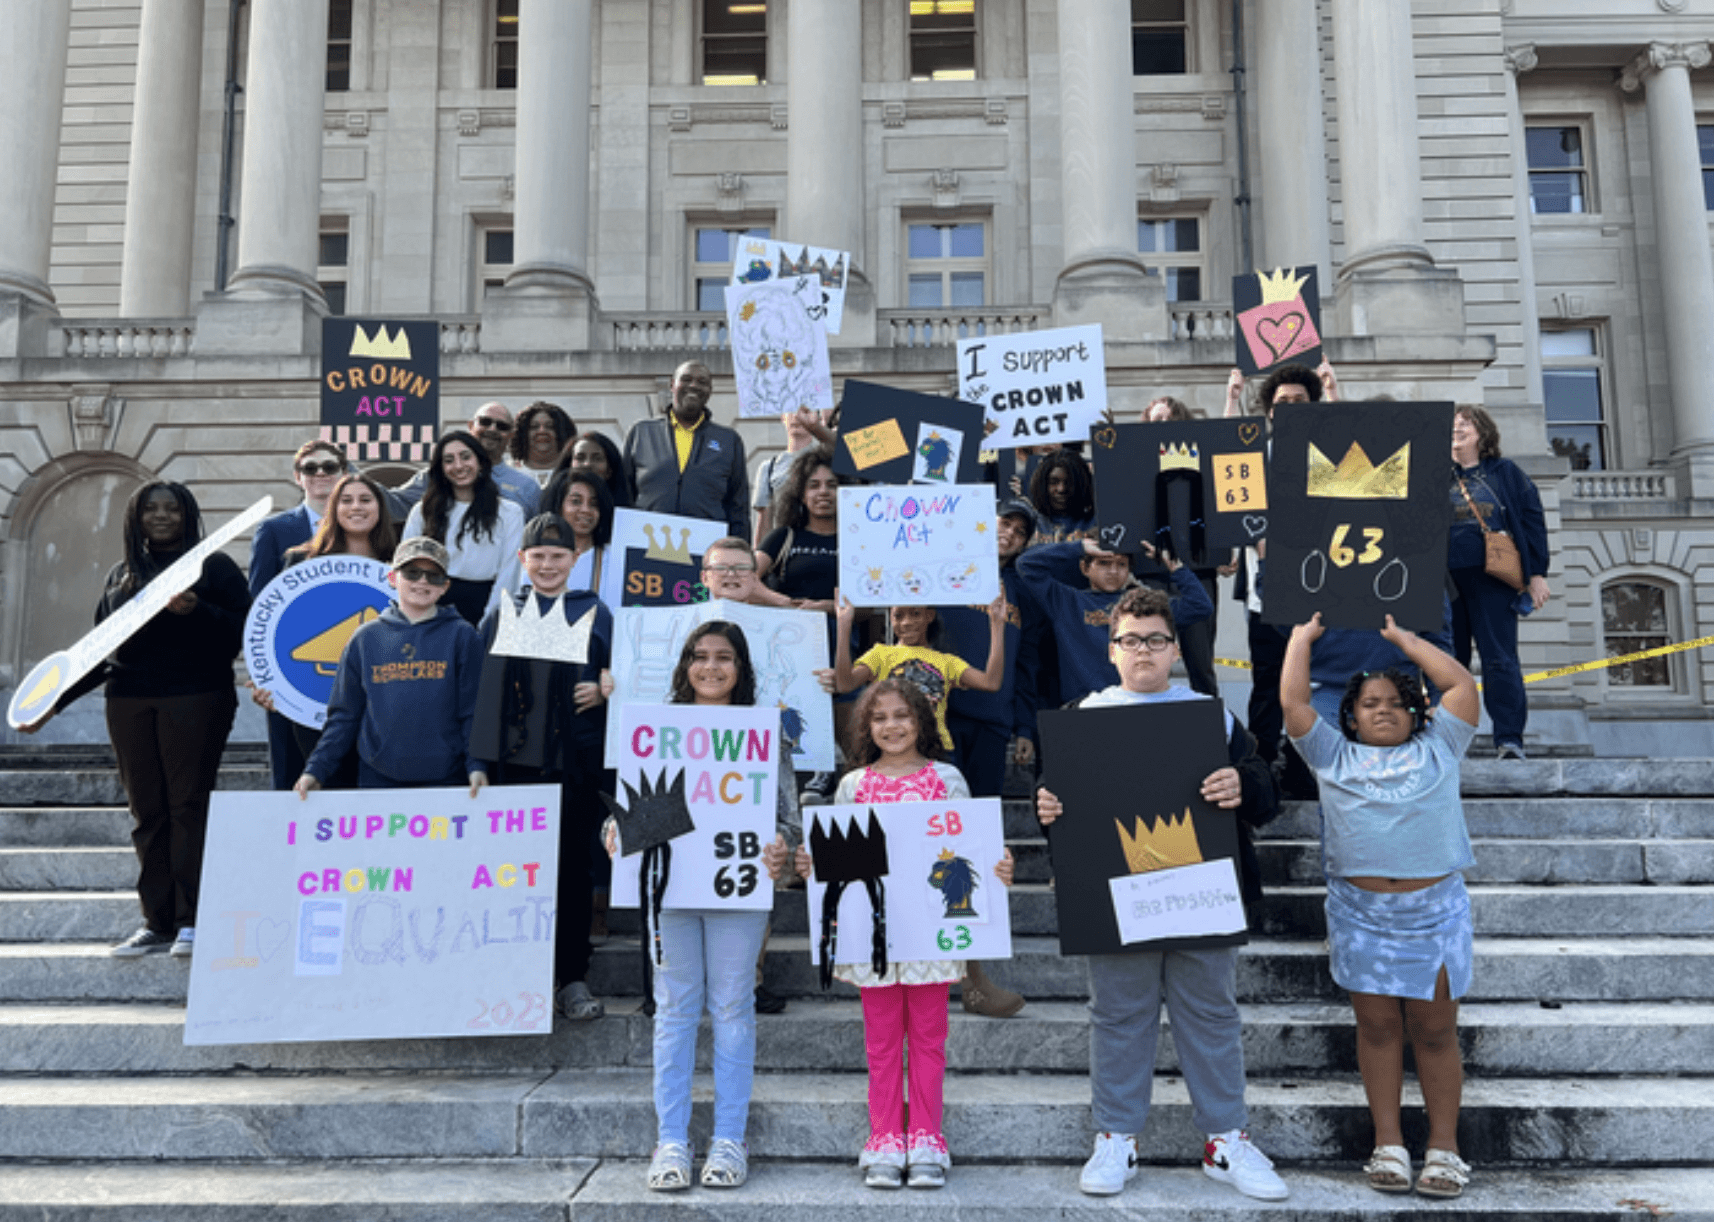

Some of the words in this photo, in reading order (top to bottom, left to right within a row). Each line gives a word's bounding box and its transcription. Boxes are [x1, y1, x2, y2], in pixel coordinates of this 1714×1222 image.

[964, 343, 987, 382] I
[326, 363, 431, 398] CROWN
[991, 379, 1085, 412] CROWN
[355, 395, 407, 417] ACT
[1012, 412, 1068, 438] ACT
[1225, 462, 1250, 481] SB
[1225, 486, 1250, 505] 63
[1329, 523, 1384, 568] 63
[626, 571, 664, 597] SB
[672, 580, 709, 605] 63
[249, 587, 285, 686] Kentucky
[282, 559, 371, 591] Student
[631, 724, 771, 762] CROWN
[690, 770, 768, 805] ACT
[287, 821, 297, 846] I
[315, 812, 469, 842] SUPPORT
[486, 806, 549, 835] THE
[926, 809, 963, 837] SB
[713, 831, 761, 860] SB
[297, 866, 414, 896] CROWN
[471, 861, 541, 890] ACT
[713, 863, 760, 899] 63
[936, 924, 973, 952] 63
[466, 990, 548, 1030] 2023
